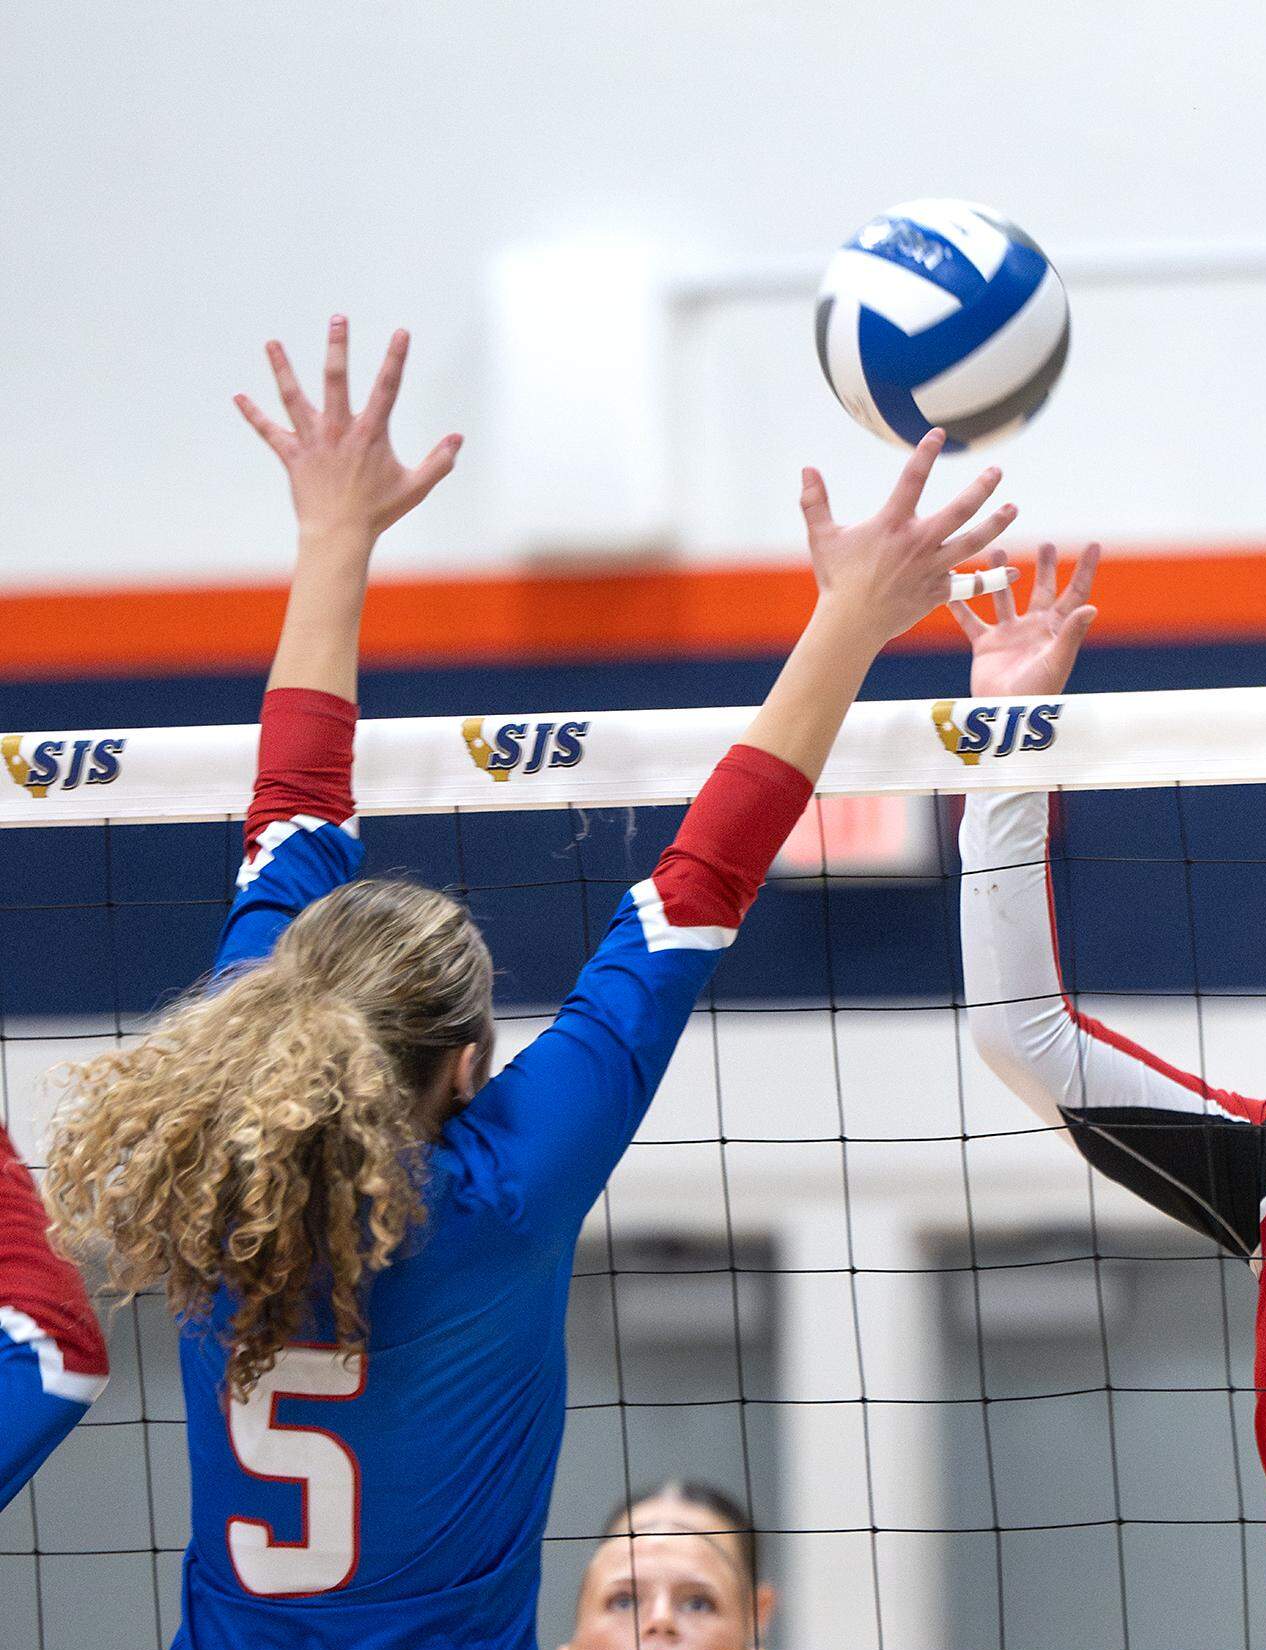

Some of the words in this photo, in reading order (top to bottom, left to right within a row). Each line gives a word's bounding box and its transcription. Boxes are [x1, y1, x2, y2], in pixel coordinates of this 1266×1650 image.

[487, 721, 591, 774] SJS
[957, 704, 1064, 757] SJS
[23, 738, 128, 791] SJS
[226, 1341, 368, 1599] 5
